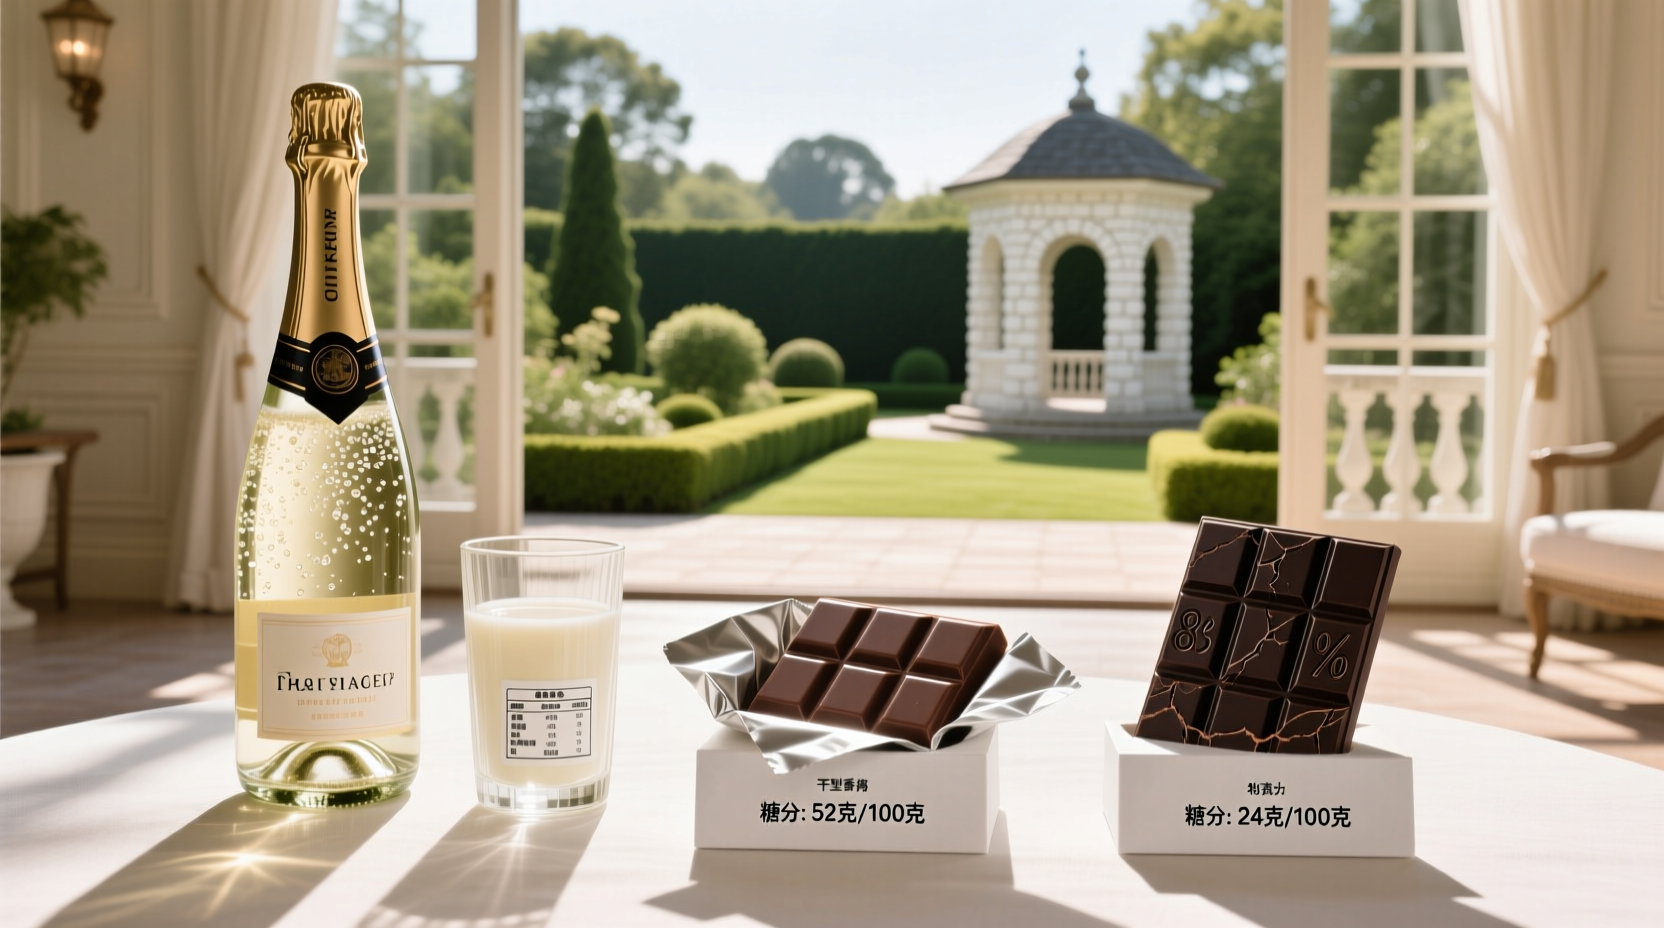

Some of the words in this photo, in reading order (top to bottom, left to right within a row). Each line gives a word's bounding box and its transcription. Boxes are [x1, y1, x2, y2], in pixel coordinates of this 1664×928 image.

[1312, 631, 1351, 680] %
[760, 801, 806, 823] 糖分:
[811, 801, 926, 824] 52克/100克
[1185, 804, 1231, 827] 糖分:
[1238, 804, 1351, 828] 24克/100克
